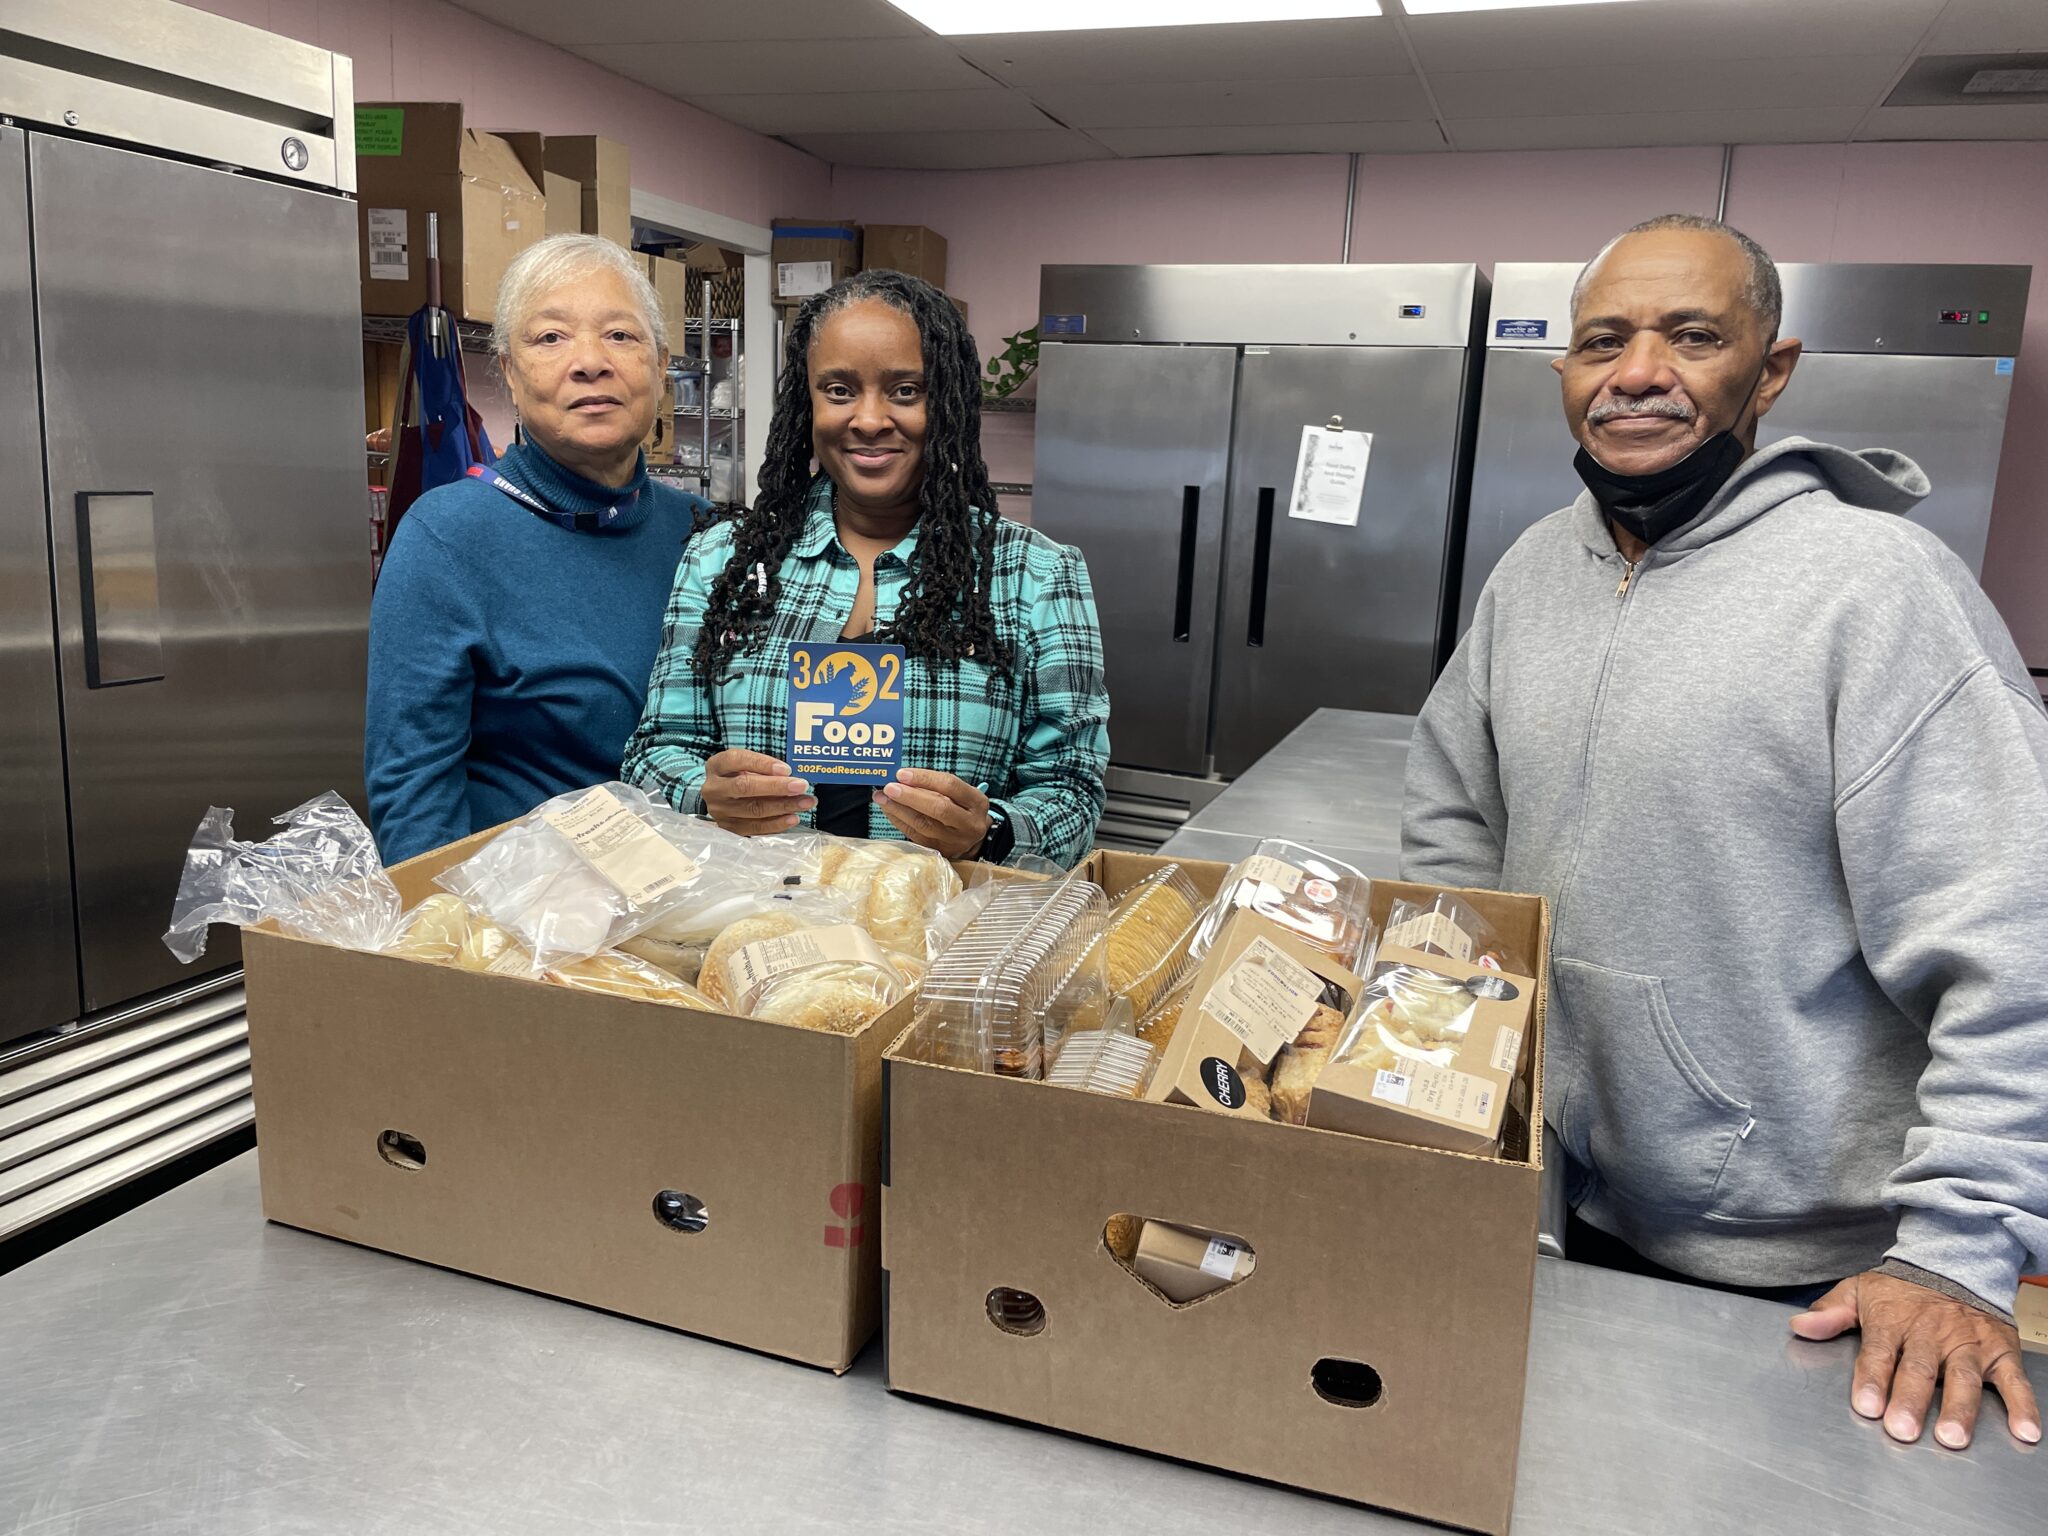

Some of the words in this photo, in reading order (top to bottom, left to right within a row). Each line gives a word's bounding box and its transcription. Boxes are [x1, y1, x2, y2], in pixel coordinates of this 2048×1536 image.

[793, 745, 850, 756] RESCUE
[853, 747, 893, 757] CREW
[797, 764, 888, 777] 302FoodRescue.org
[1216, 1060, 1231, 1106] CHERRY
